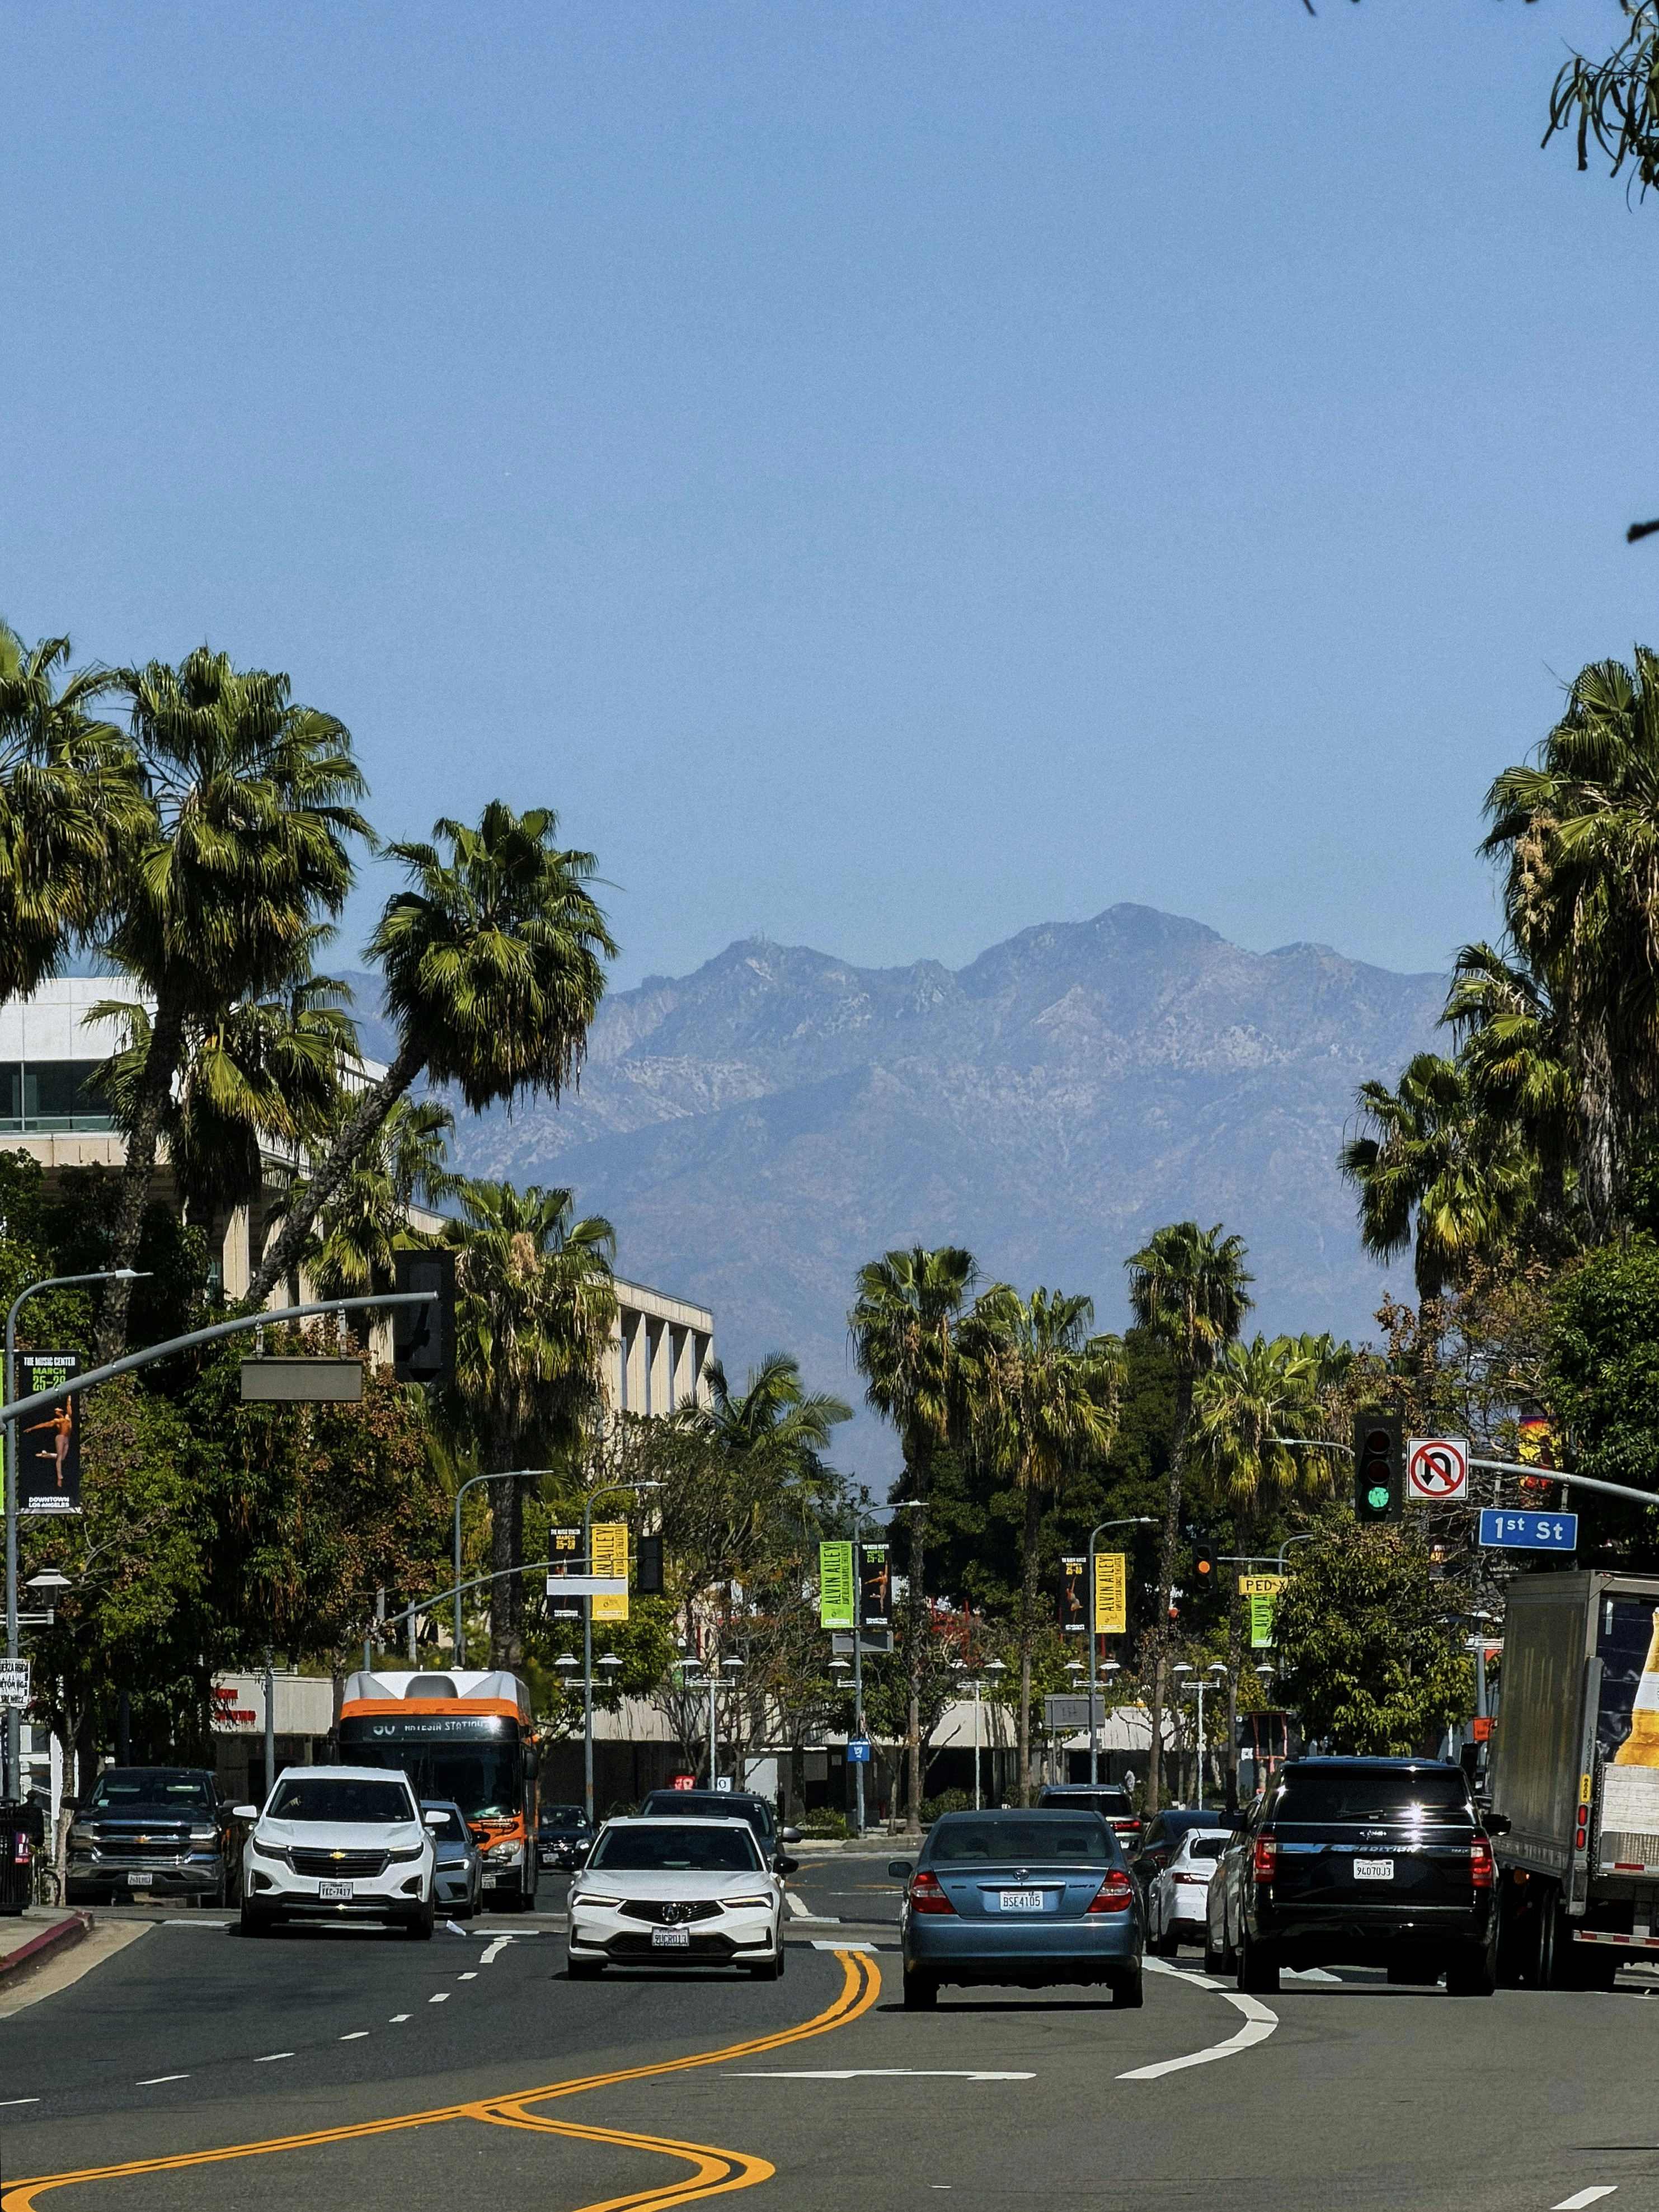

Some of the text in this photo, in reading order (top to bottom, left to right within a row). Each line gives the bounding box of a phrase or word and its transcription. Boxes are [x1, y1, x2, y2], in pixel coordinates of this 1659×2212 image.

[24, 1357, 34, 1366] THE
[1495, 1517, 1563, 1540] 1st St
[596, 1529, 614, 1560] AILEY
[824, 1545, 840, 1573] AILEY
[1098, 1557, 1114, 1583] AILEY
[825, 1577, 841, 1604] ALVIN
[1246, 1580, 1272, 1591] PED
[1099, 1586, 1114, 1611] ALVIN
[1254, 1604, 1270, 1627] ALVIN
[1003, 1896, 1041, 1907] BSE4105
